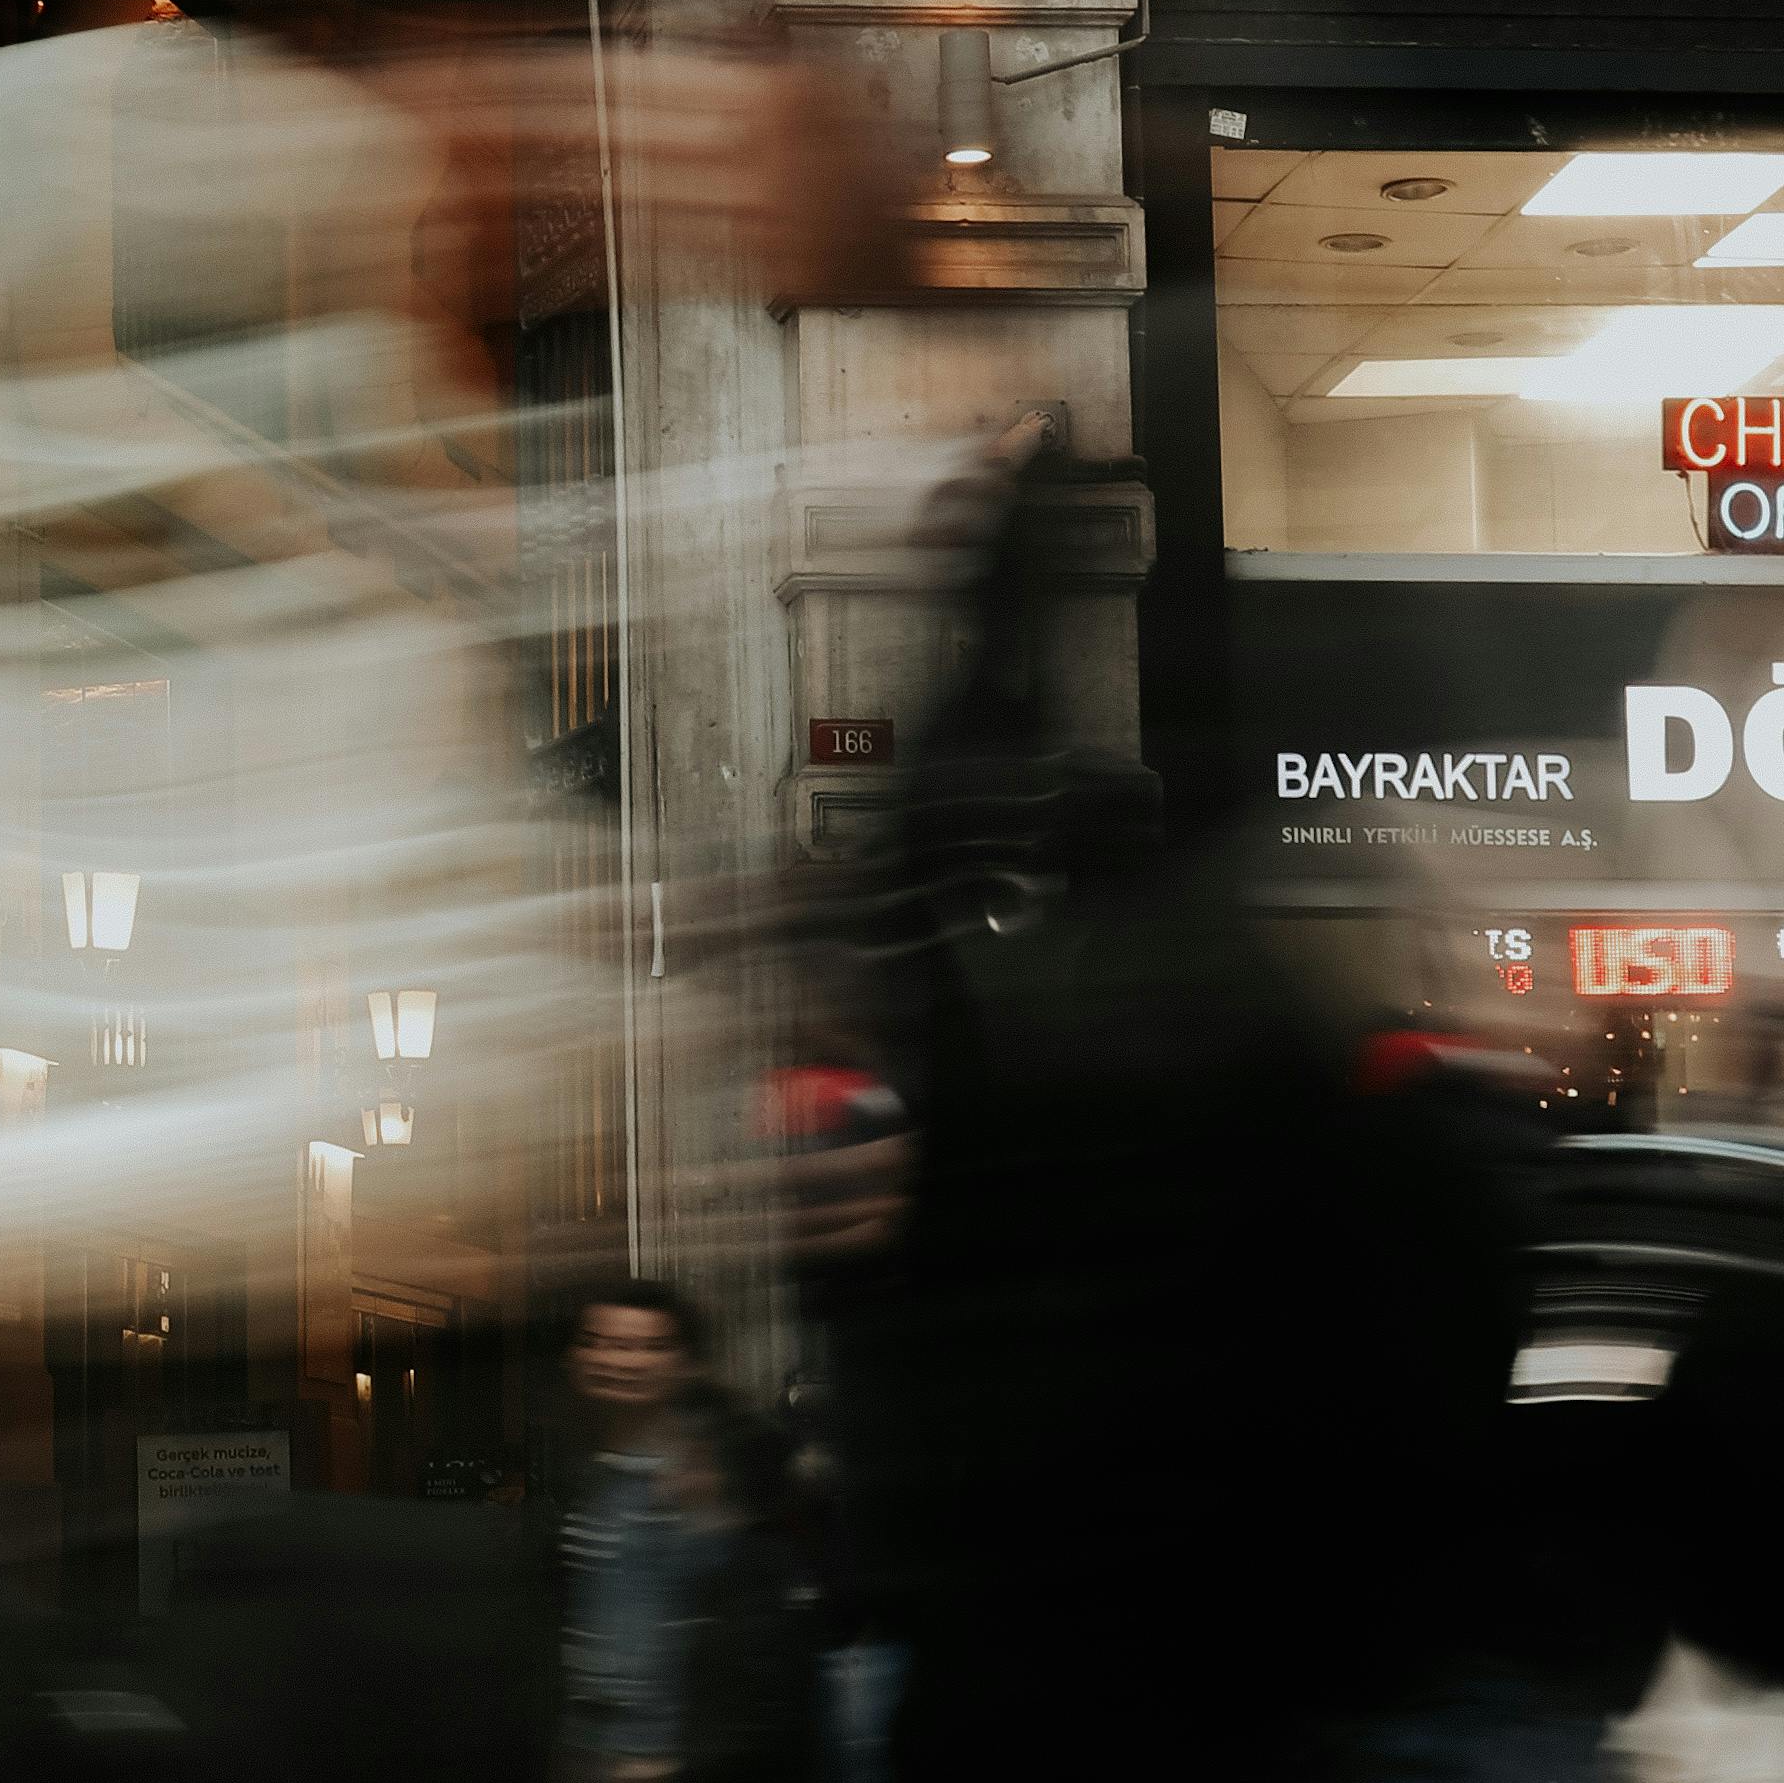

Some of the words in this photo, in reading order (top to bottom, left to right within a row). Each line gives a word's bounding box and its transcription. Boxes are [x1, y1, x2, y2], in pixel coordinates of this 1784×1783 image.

[832, 730, 873, 754] 166
[1276, 752, 1574, 801] BAYRAKTAR
[1281, 827, 1352, 845] SINIRLI
[1363, 822, 1439, 846] YETKİLİ
[1450, 824, 1551, 847] MÜESSESE
[1560, 828, 1599, 852] A.Ş.
[1568, 923, 1736, 996] USD
[156, 1447, 210, 1463] Gerçek
[147, 1466, 225, 1481] Coca-Cola
